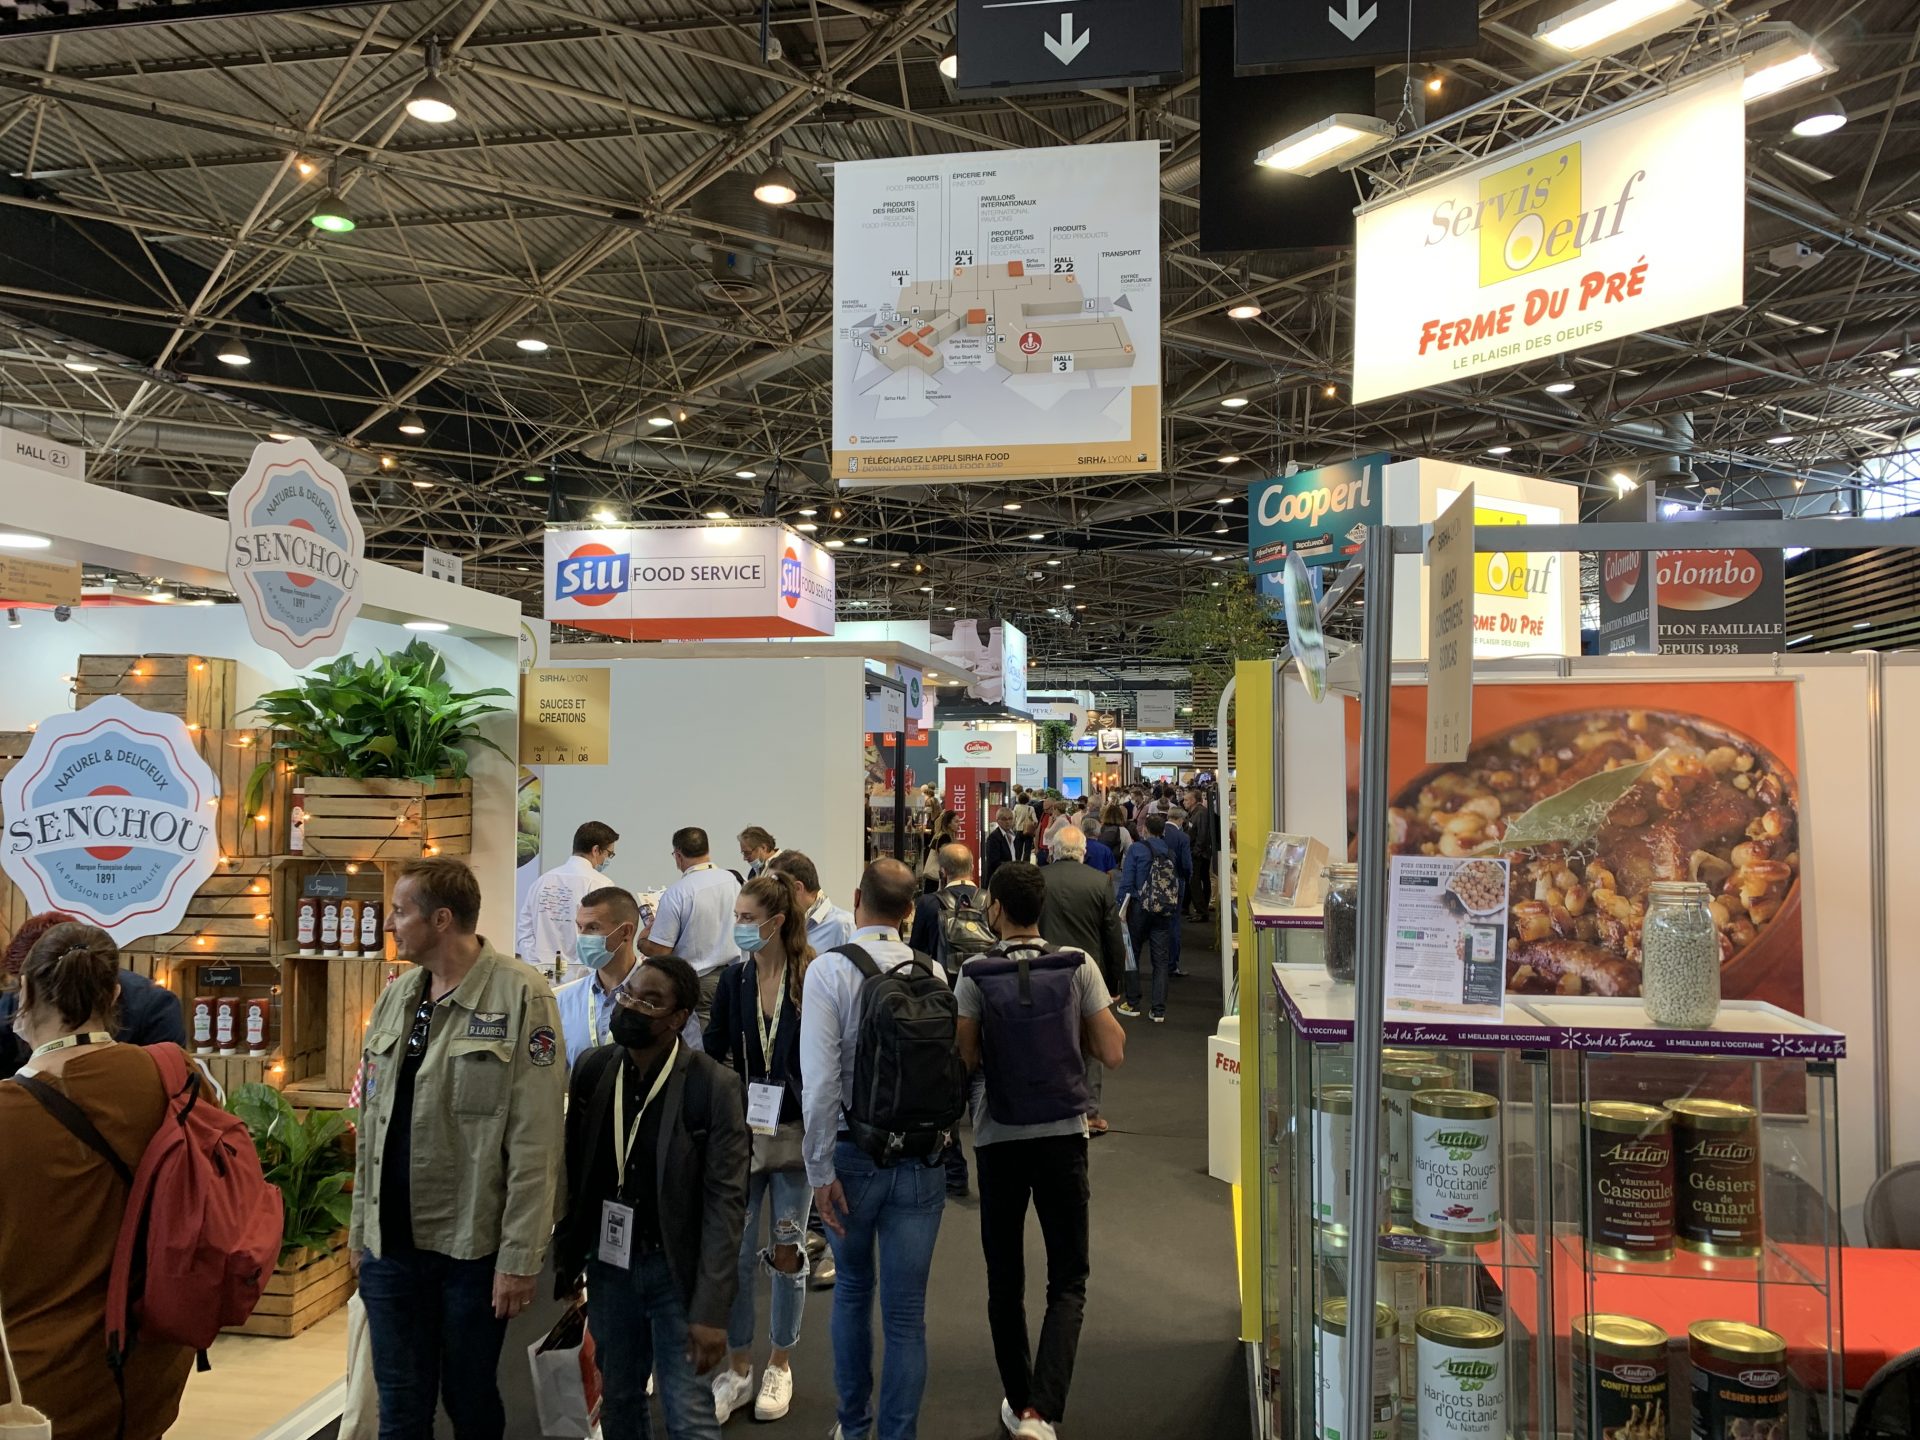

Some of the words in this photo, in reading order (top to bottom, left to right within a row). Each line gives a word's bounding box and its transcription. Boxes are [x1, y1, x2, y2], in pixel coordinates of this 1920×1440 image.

[906, 175, 939, 183] PRODUITS
[981, 194, 1015, 202] PAVILLONS
[981, 200, 1037, 208] INTERNATIONAUX
[1424, 155, 1568, 247] Servis'
[1503, 169, 1646, 271] Oeuf
[991, 229, 1024, 237] PRODUITS
[955, 256, 973, 265] 2.1
[1102, 250, 1141, 258] TRANSPORT
[1054, 263, 1074, 273] 2.2
[898, 277, 903, 285] 1
[1453, 357, 1468, 370] LE
[1472, 343, 1521, 365] PLAISIR
[1525, 335, 1552, 351] DES
[1556, 320, 1603, 343] OEUFS
[1059, 362, 1067, 371] 3
[16, 443, 46, 461] HALL
[52, 453, 67, 465] 2.1
[862, 456, 923, 465] TÉLÉCHARGEZ
[925, 455, 956, 463] L'APPLI
[957, 453, 984, 461] SIRHA
[985, 453, 1010, 461] FOOD
[1108, 455, 1132, 463] LYON
[1258, 464, 1371, 528] Cooperl
[266, 486, 297, 517] NATUREL
[298, 486, 304, 497] &
[306, 488, 338, 533] DELICIEUX
[234, 532, 359, 590] SENCHOU
[432, 556, 446, 568] HALL
[1604, 550, 1640, 582] Colombo
[562, 557, 624, 594] Sill
[632, 566, 685, 583] FOOD
[691, 564, 761, 581] SERVICE
[782, 563, 800, 594] Sill
[1657, 560, 1756, 586] olombo
[801, 576, 815, 594] FOOD
[816, 583, 832, 602] SERVICE
[1474, 614, 1497, 632] RME
[1623, 608, 1649, 628] FAMILIALE
[1701, 623, 1783, 635] FAMILIALE
[1610, 637, 1626, 652] DEPUIS
[1708, 644, 1739, 655] 1938
[567, 674, 588, 682] LYON
[540, 699, 573, 709] SAUCES
[575, 699, 586, 709] ET
[539, 712, 586, 723] CREATIONS
[535, 754, 541, 762] 3
[558, 754, 565, 762] A
[578, 754, 589, 762] 08
[54, 752, 101, 792] NATUREL
[104, 750, 113, 761] &
[117, 749, 169, 791] DELICIEUX
[9, 805, 208, 855] SENCHOU
[75, 864, 96, 872] Marque
[97, 863, 122, 872] Française
[123, 864, 142, 872] depuis
[64, 875, 99, 900] PASSION
[102, 893, 114, 901] DE
[117, 888, 129, 900] LA
[131, 863, 161, 895] QUALITE
[96, 873, 116, 884] 1891
[469, 1025, 506, 1037] R.LAUREN
[1308, 1027, 1349, 1035] L'OCCITANIE
[1400, 1028, 1413, 1041] de
[1413, 1026, 1449, 1041] France
[1467, 1033, 1500, 1041] MEILLEUR
[1511, 1034, 1552, 1042] L'OCCITANIE
[1582, 1033, 1603, 1048] Sud
[1604, 1035, 1618, 1048] de
[1618, 1032, 1656, 1048] France
[1676, 1039, 1710, 1048] MEILLEUR
[1721, 1041, 1765, 1049] L'OCCITANIE
[1794, 1040, 1816, 1054] Sud
[1817, 1042, 1833, 1054] de
[1424, 1128, 1489, 1151] Audary
[1600, 1143, 1670, 1167] Audary
[1685, 1140, 1756, 1164] Audary
[1415, 1156, 1458, 1176] Haricots
[1463, 1163, 1497, 1180] Rouges
[1426, 1173, 1488, 1190] d'Occitanie
[1598, 1178, 1673, 1200] Cassoulet
[1689, 1173, 1756, 1193] Gésiers
[1435, 1189, 1447, 1199] Au
[1449, 1191, 1479, 1200] Naturel
[1720, 1194, 1733, 1204] de
[1692, 1199, 1755, 1215] canard
[1704, 1214, 1748, 1224] émincés
[1432, 1357, 1499, 1380] Audary
[1601, 1380, 1630, 1392] CONFIT
[1631, 1385, 1642, 1393] DE
[1424, 1384, 1473, 1407] Haricots
[1757, 1395, 1769, 1404] DE
[1436, 1403, 1498, 1423] d'Occitanie
[1446, 1421, 1458, 1431] Au
[1460, 1422, 1490, 1432] Naturel
